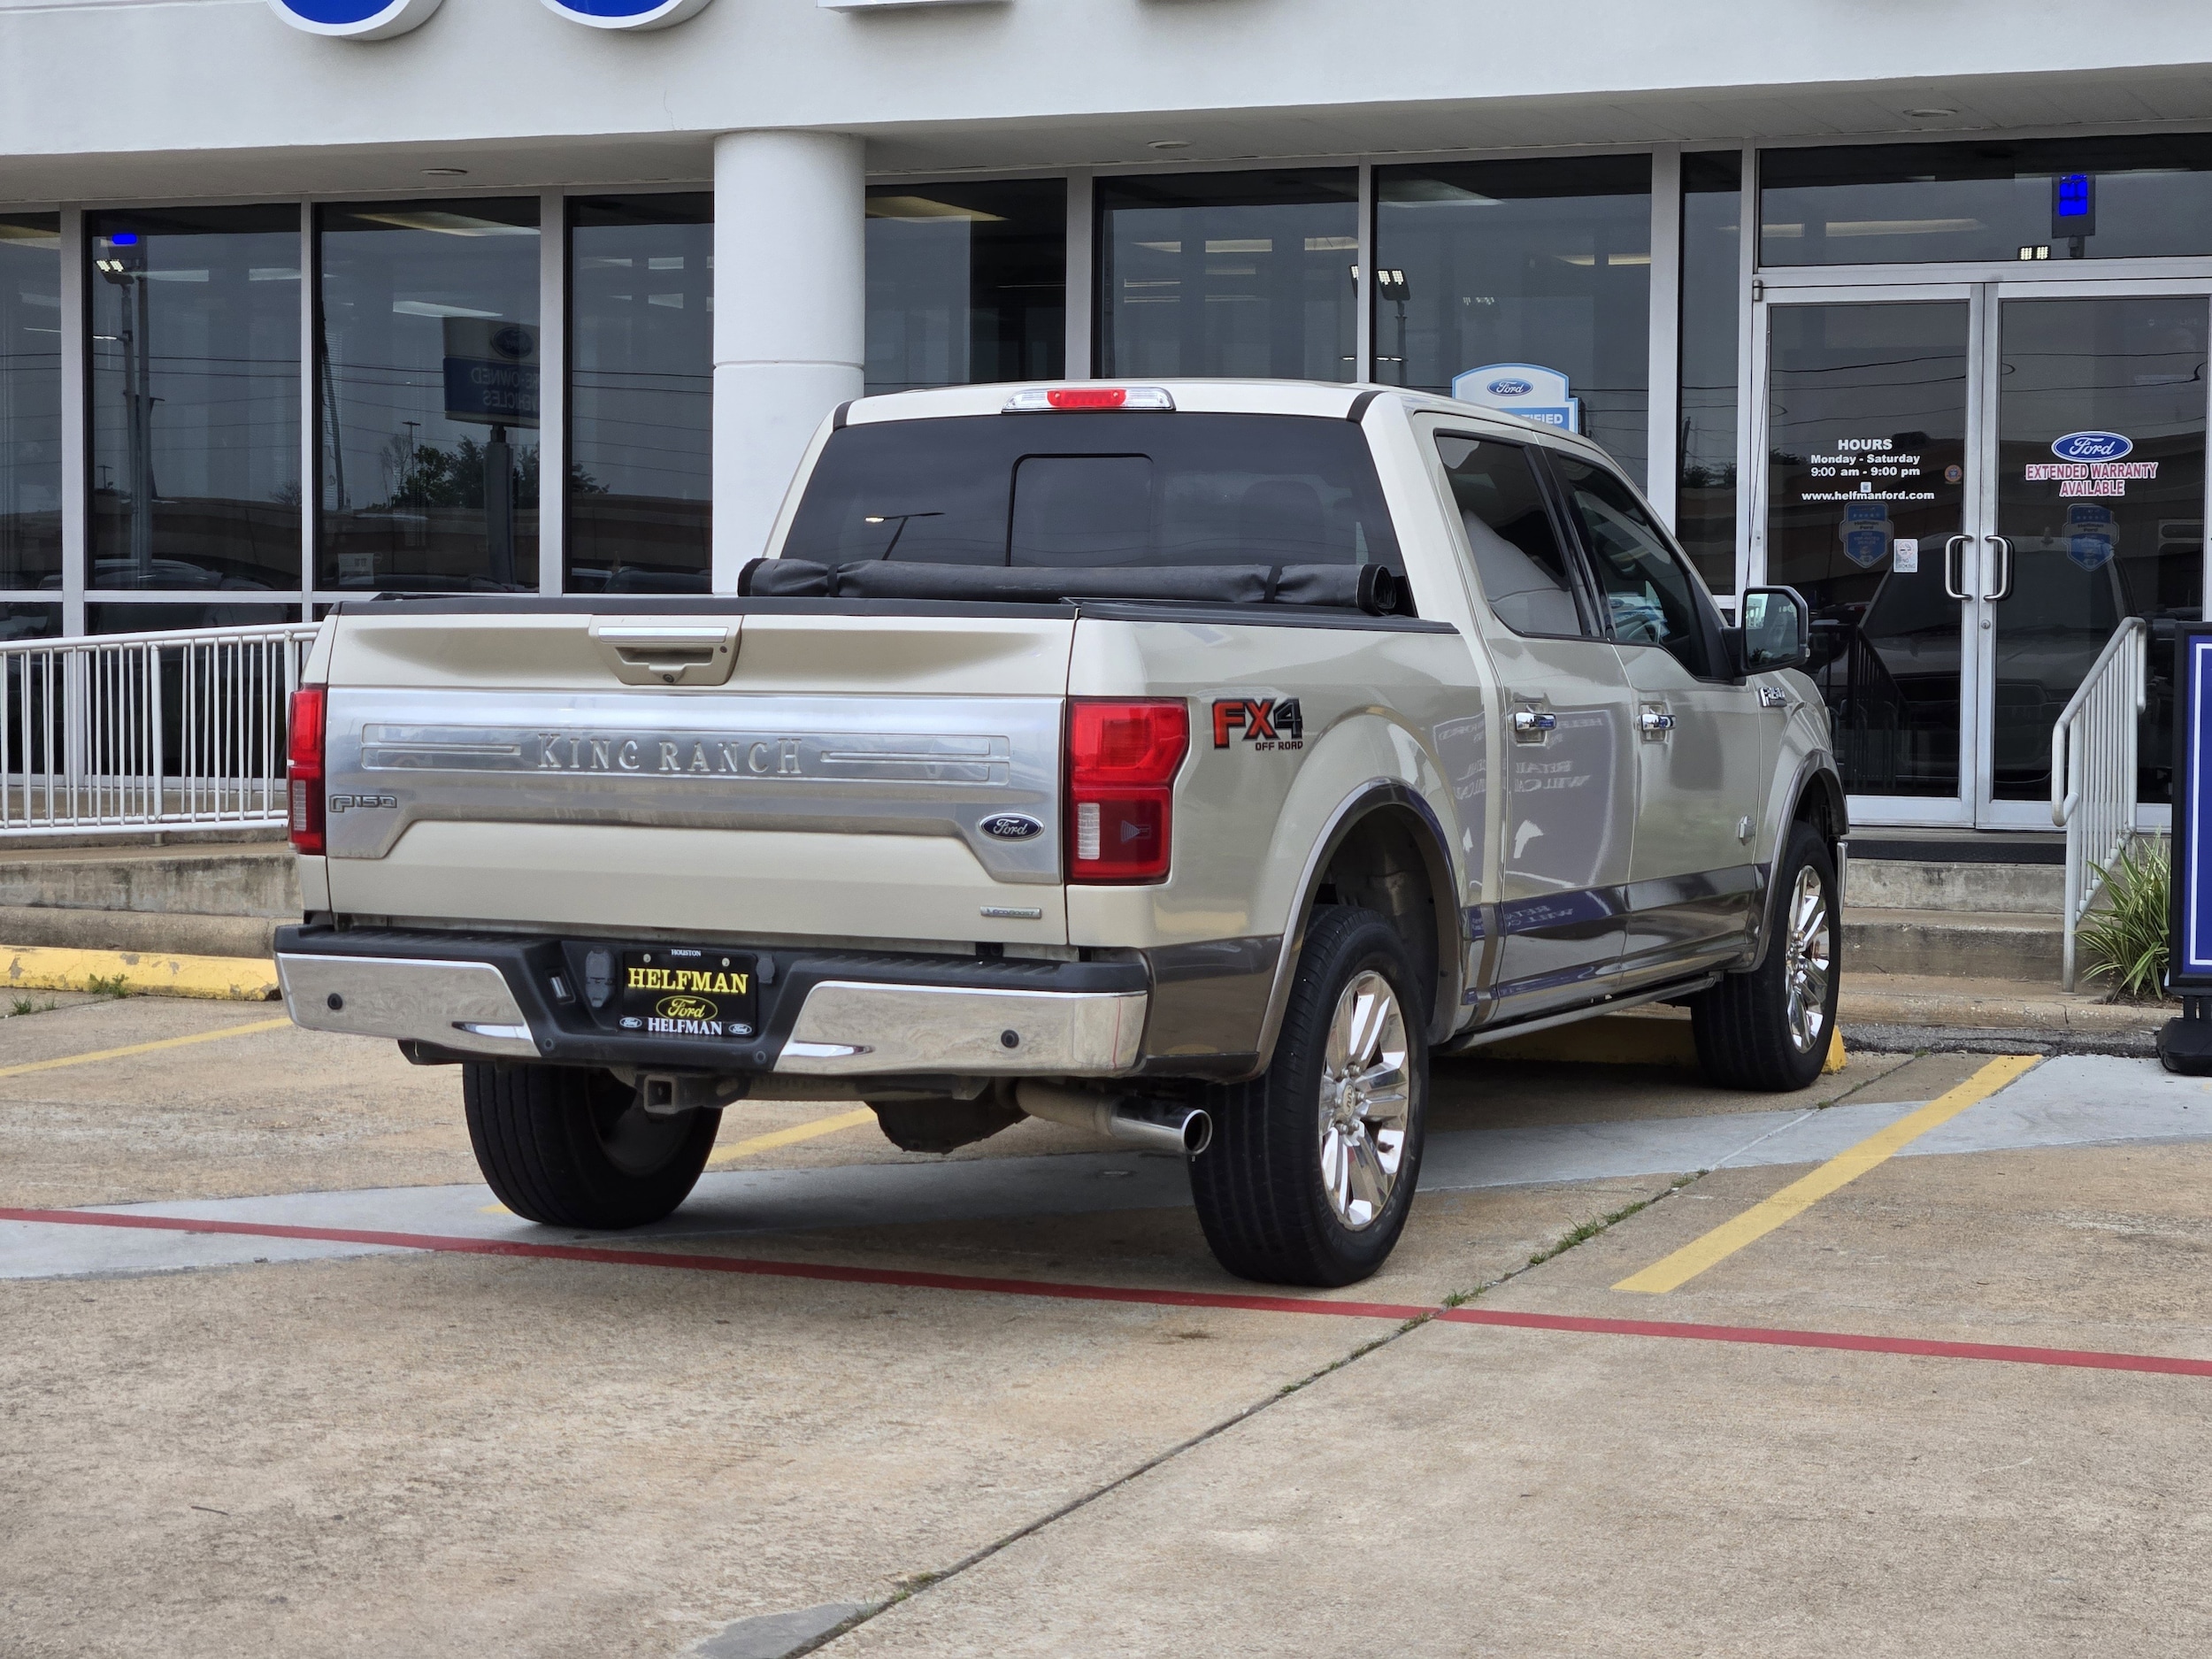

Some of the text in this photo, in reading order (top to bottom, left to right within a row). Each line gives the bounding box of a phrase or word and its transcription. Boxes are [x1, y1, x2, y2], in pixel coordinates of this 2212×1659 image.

[1496, 380, 1525, 394] Ford
[1838, 439, 1893, 450] HOURS
[2069, 436, 2116, 456] Ford
[1810, 454, 1856, 465] Monday
[1867, 454, 1920, 465] Saturday
[1811, 466, 1836, 477] 9:00
[1870, 466, 1897, 476] 9:00
[1901, 468, 1920, 478] pm
[2026, 463, 2158, 480] EXTENDED WARRANTY
[1801, 491, 1935, 500] www.helfmanford.com
[2059, 480, 2125, 496] AVAILABLE
[1212, 698, 1303, 749] FX4
[538, 733, 802, 773] KING RANCH
[1279, 741, 1303, 750] ROAD
[993, 818, 1028, 835] Ford
[628, 968, 749, 995] HELFMAN
[668, 998, 705, 1018] Ford
[648, 1017, 722, 1035] HELFMAN
